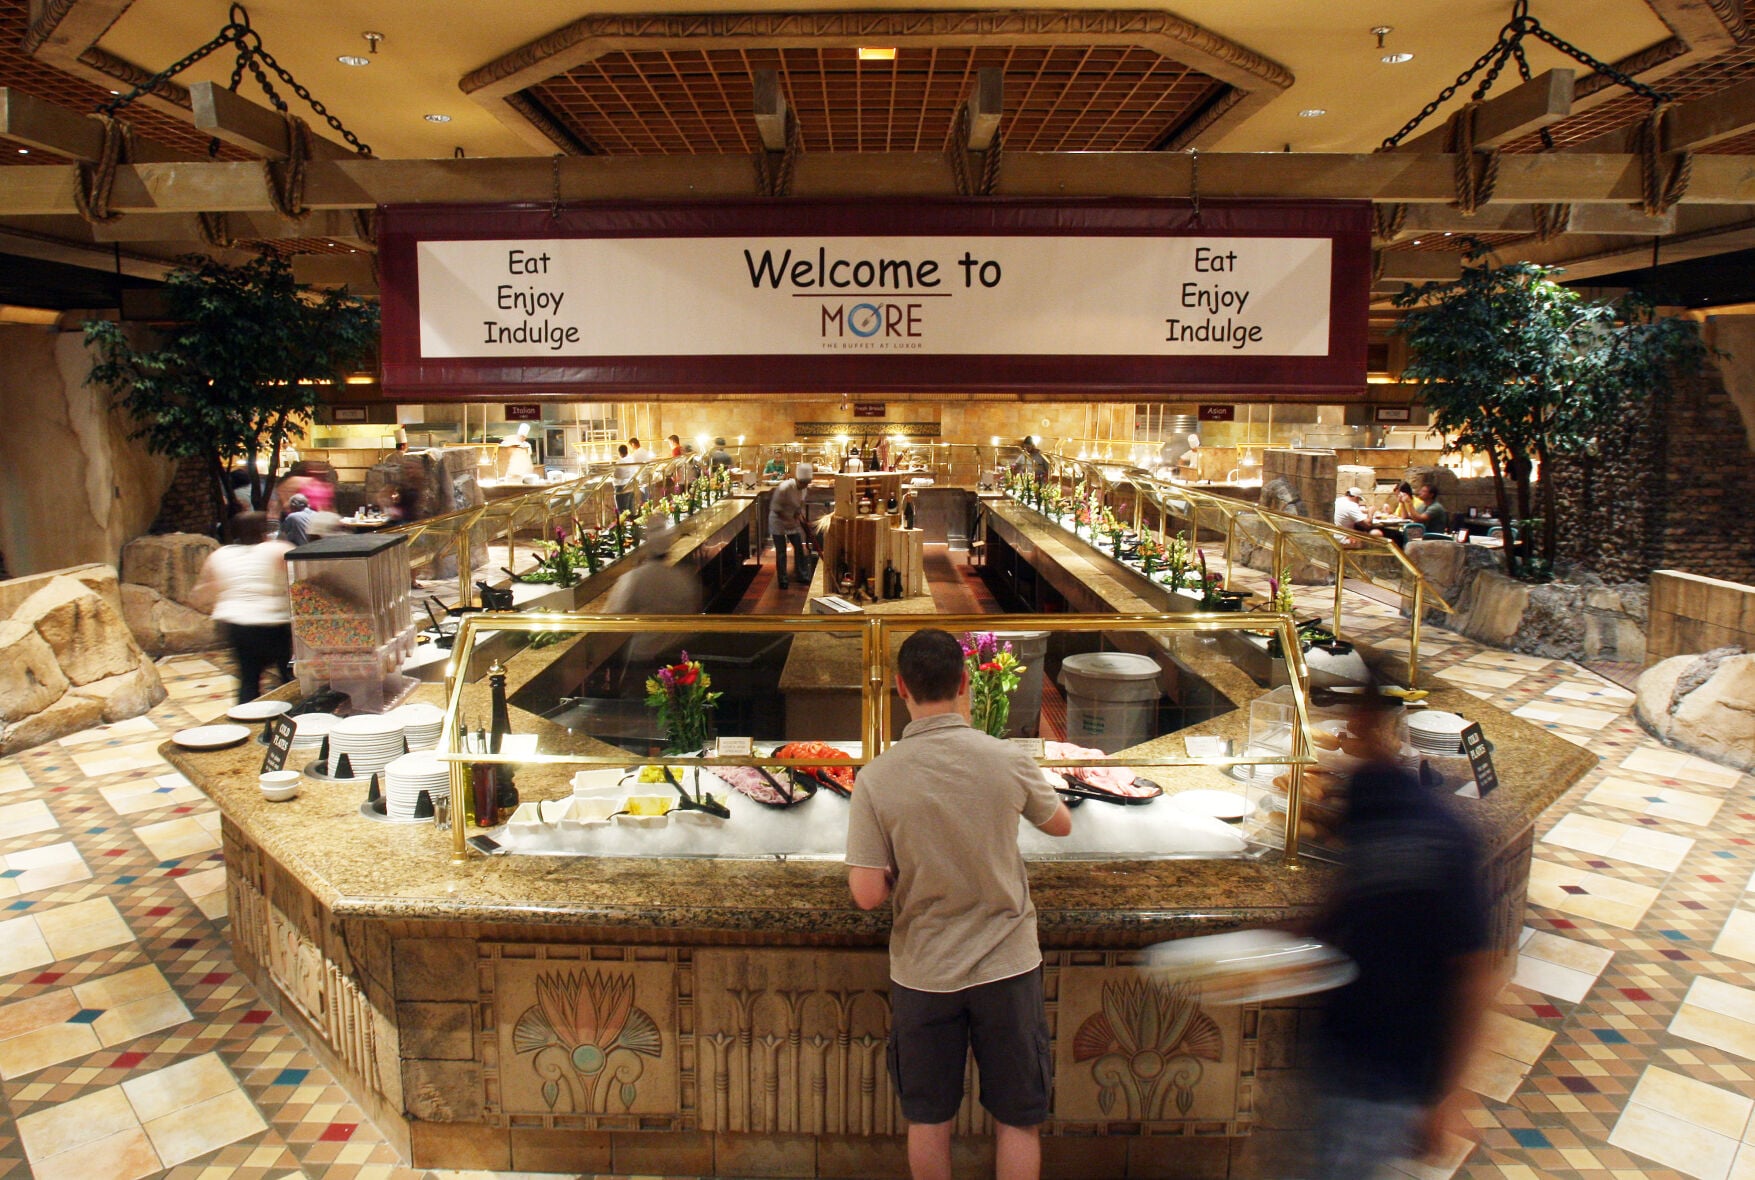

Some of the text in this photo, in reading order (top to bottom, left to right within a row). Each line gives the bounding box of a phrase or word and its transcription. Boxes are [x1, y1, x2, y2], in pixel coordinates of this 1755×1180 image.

[509, 250, 551, 275] Eat
[744, 247, 1002, 290] Welcome to
[1195, 248, 1238, 273] Eat
[498, 285, 564, 316] Enjoy
[1182, 283, 1250, 315] Enjoy
[483, 319, 580, 350] Indulge
[822, 303, 923, 338] MORE
[1166, 317, 1263, 350] Indulge
[512, 406, 536, 415] Italian
[1207, 407, 1227, 415] Asian
